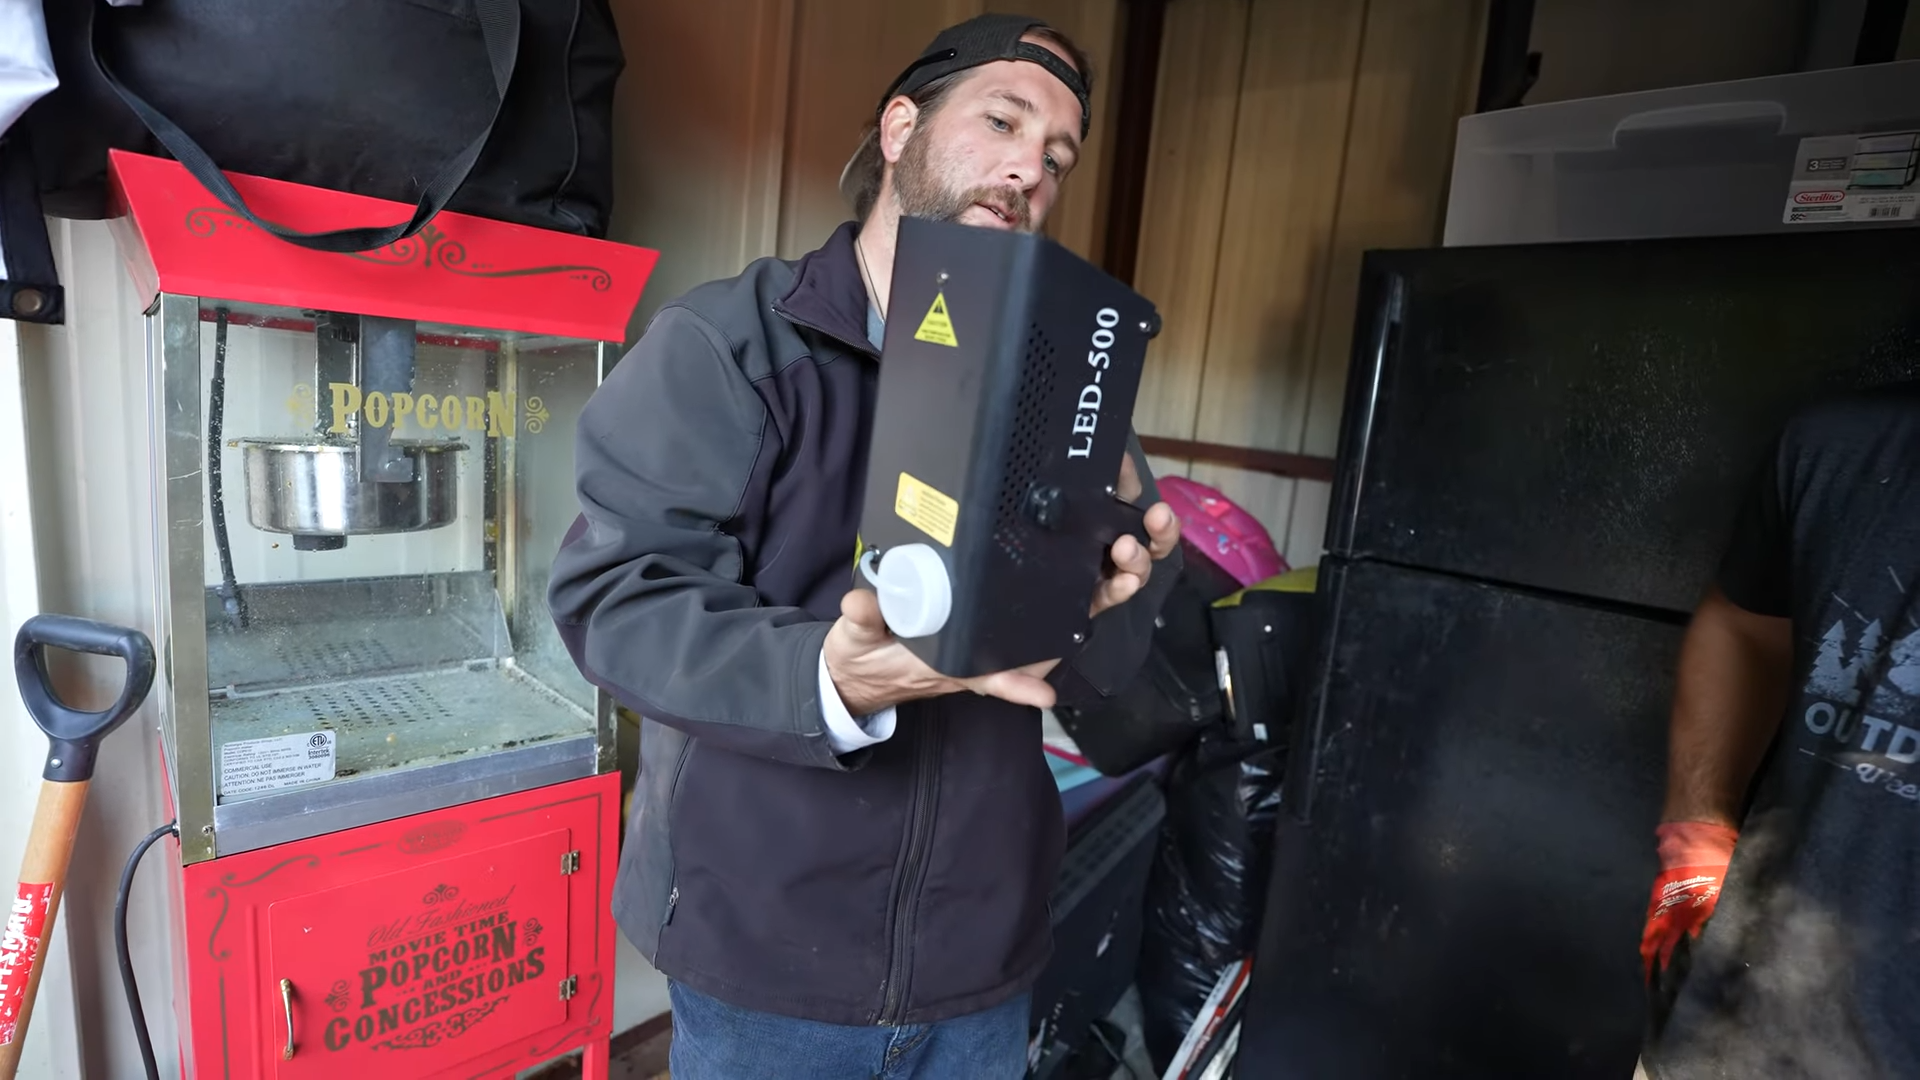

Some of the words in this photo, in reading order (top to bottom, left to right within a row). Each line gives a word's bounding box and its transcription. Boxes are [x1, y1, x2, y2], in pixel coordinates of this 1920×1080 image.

[1808, 160, 1819, 171] 3
[1798, 191, 1842, 203] Sterilite
[1067, 307, 1119, 459] LED-500
[223, 765, 260, 774] COMMERCIAL
[272, 766, 296, 774] IMMERSE
[277, 771, 306, 780] IMMERGER
[367, 914, 413, 947] Old
[415, 884, 516, 933] Fashioned
[368, 930, 447, 966] MOVIE
[454, 910, 510, 938] TIME
[358, 921, 517, 1010] POPCORN
[422, 969, 462, 991] AND
[323, 946, 546, 1052] CONCESSIONS
